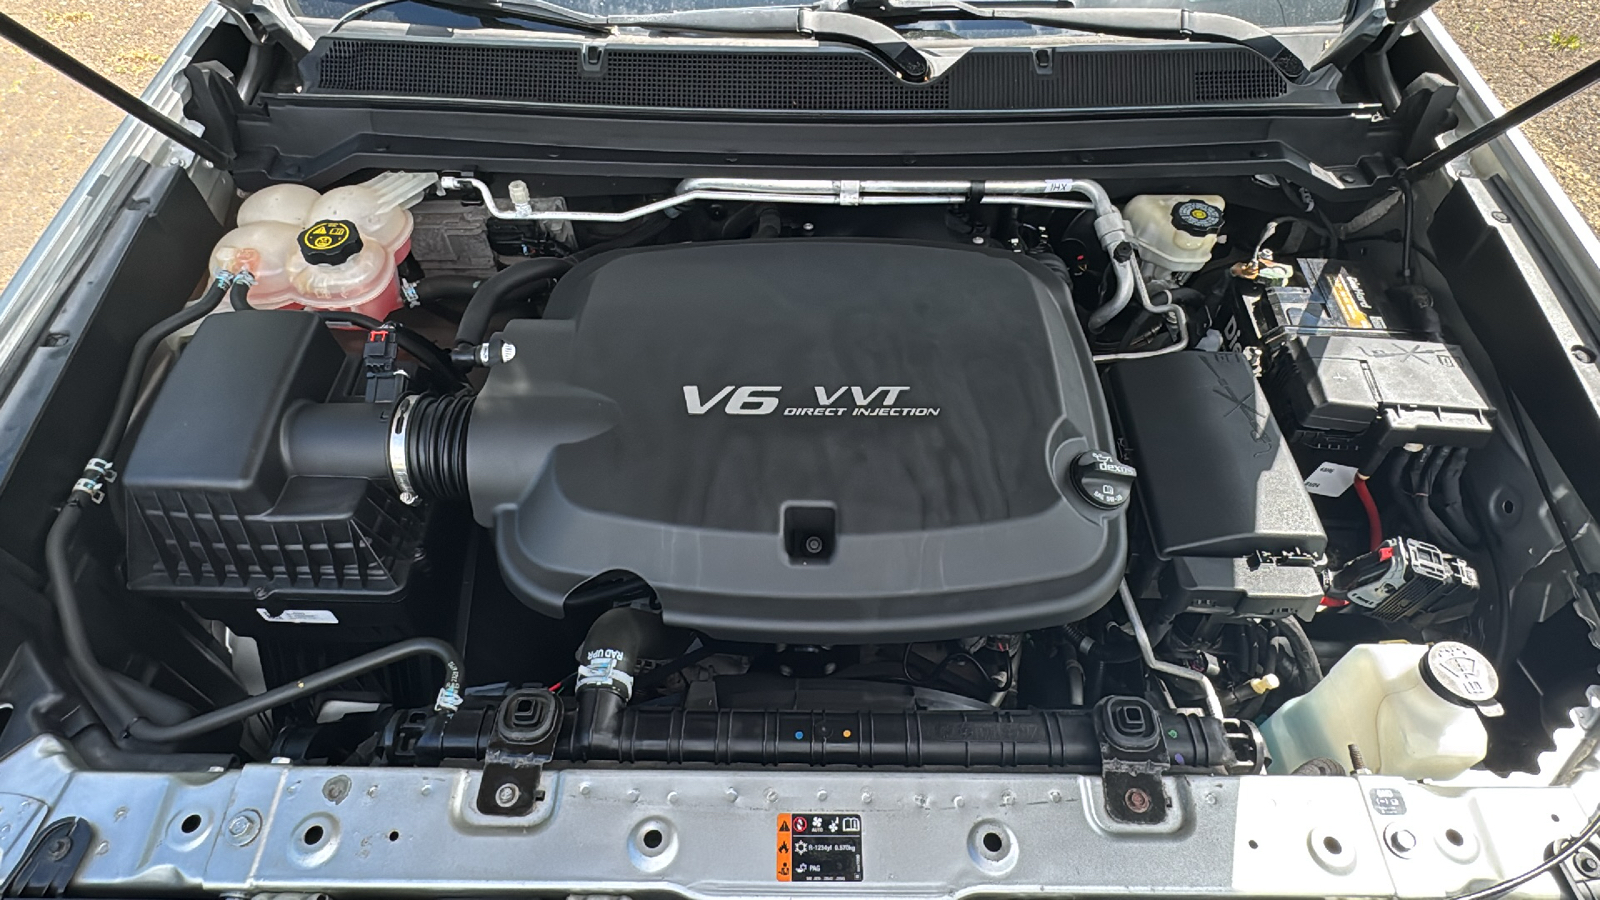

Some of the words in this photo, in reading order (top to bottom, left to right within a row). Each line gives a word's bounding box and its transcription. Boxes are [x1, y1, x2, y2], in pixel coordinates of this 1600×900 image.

[683, 385, 783, 415] V6
[814, 386, 910, 406] VVT
[783, 407, 848, 416] DIRECT
[852, 407, 941, 416] INJECTION
[1099, 461, 1134, 475] dexos
[587, 648, 604, 661] UPR
[604, 648, 624, 661] RAD
[809, 864, 821, 872] PAG
